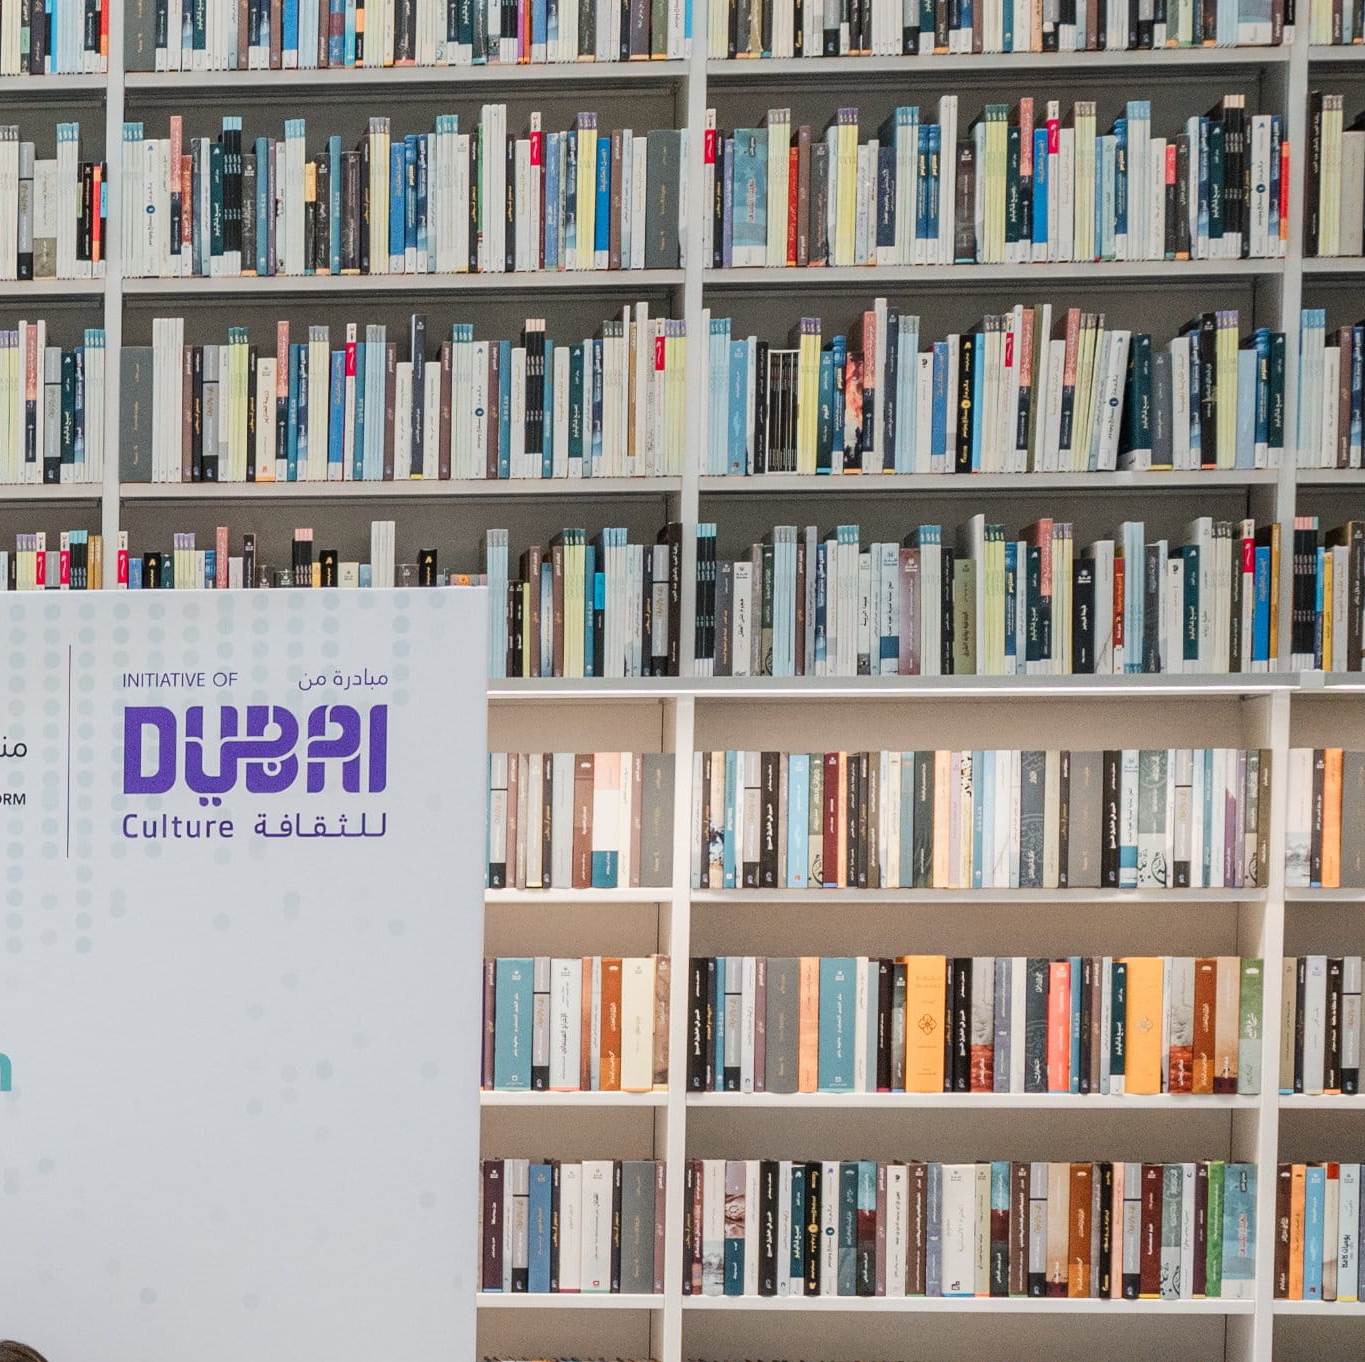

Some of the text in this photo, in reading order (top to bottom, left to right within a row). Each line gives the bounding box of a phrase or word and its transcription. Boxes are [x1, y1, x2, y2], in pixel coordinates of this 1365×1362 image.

[123, 671, 238, 688] INITIATIVE OF
[298, 667, 389, 691] مبادرة من
[123, 703, 388, 808] DUBAI
[122, 813, 234, 839] Culture
[254, 812, 387, 838] للثقافة
